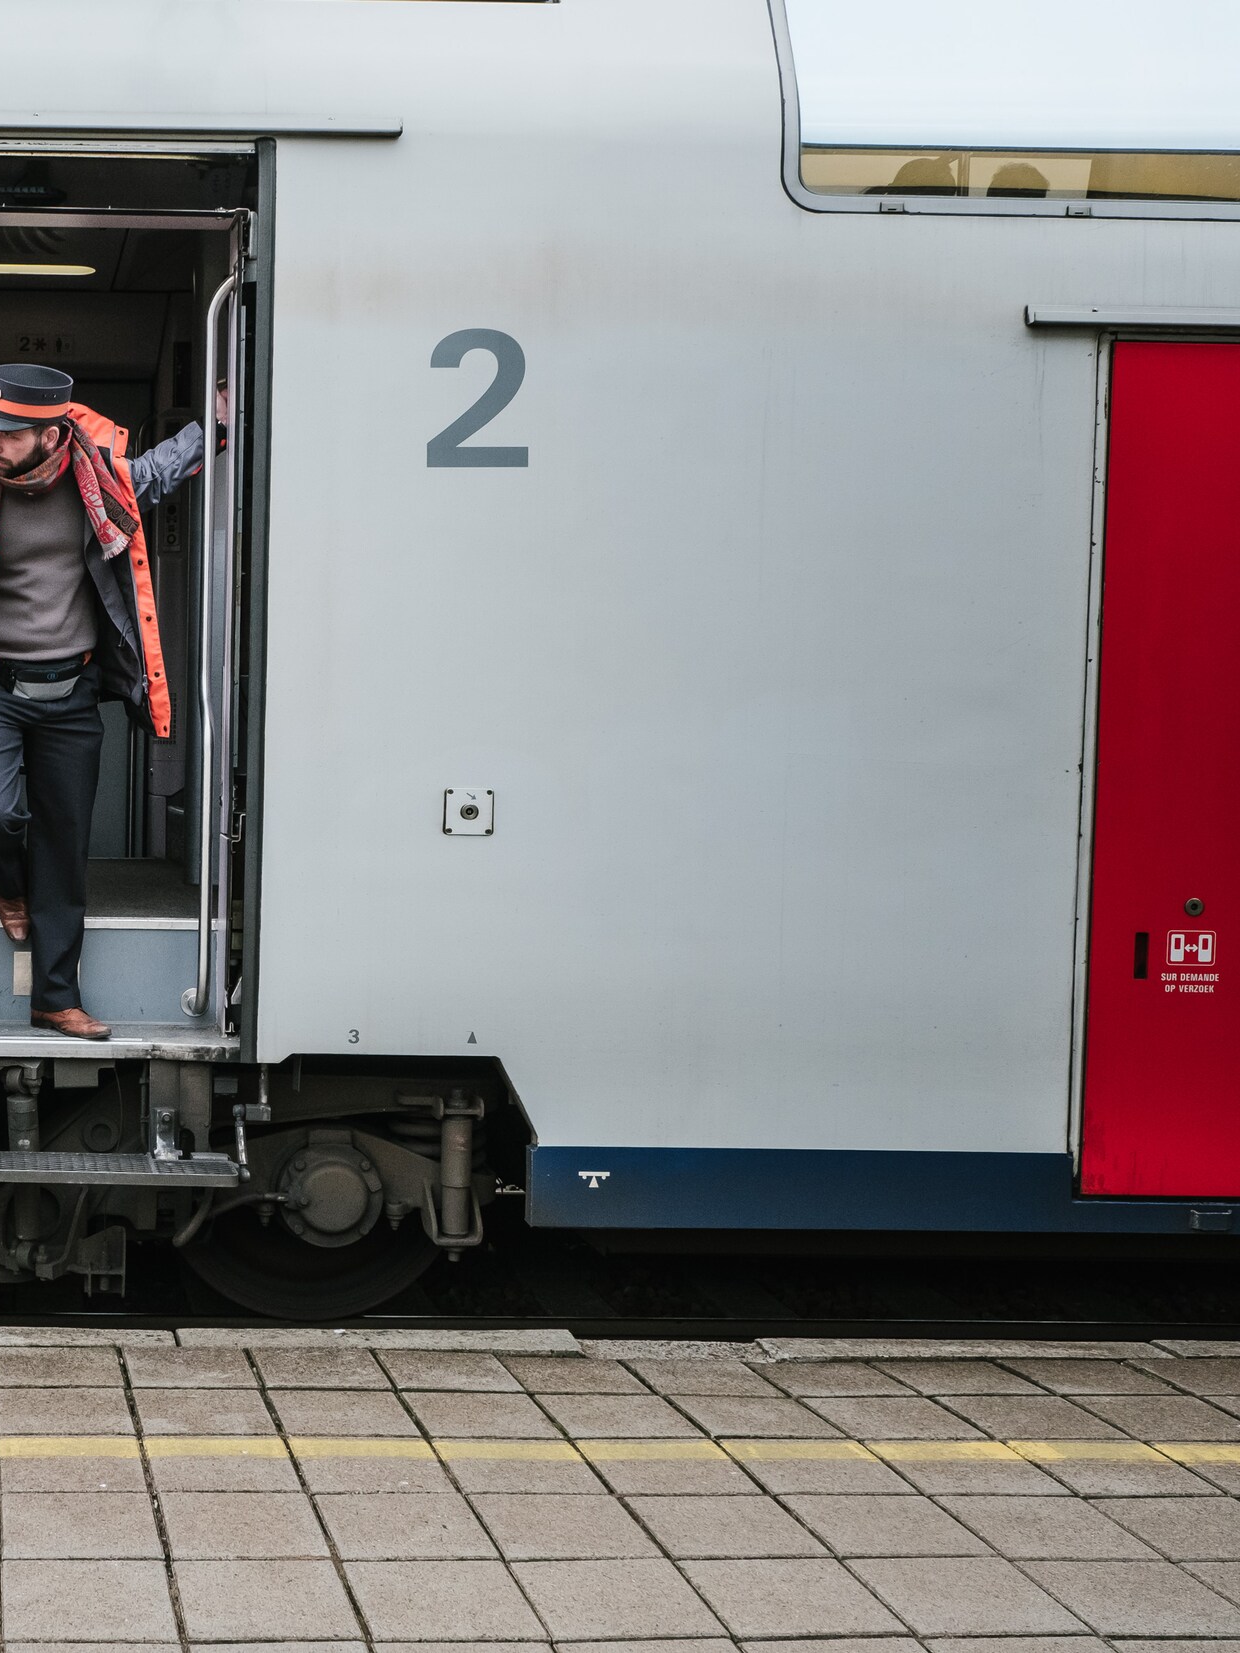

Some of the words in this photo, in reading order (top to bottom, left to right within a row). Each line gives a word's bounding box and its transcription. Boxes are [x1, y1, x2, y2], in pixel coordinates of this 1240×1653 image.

[426, 328, 529, 468] 2
[1161, 973, 1177, 982] SUR
[1180, 973, 1219, 982] DEMANDE
[1165, 985, 1175, 993] OP
[1179, 985, 1214, 993] VERZOEK
[347, 1028, 360, 1044] 3
